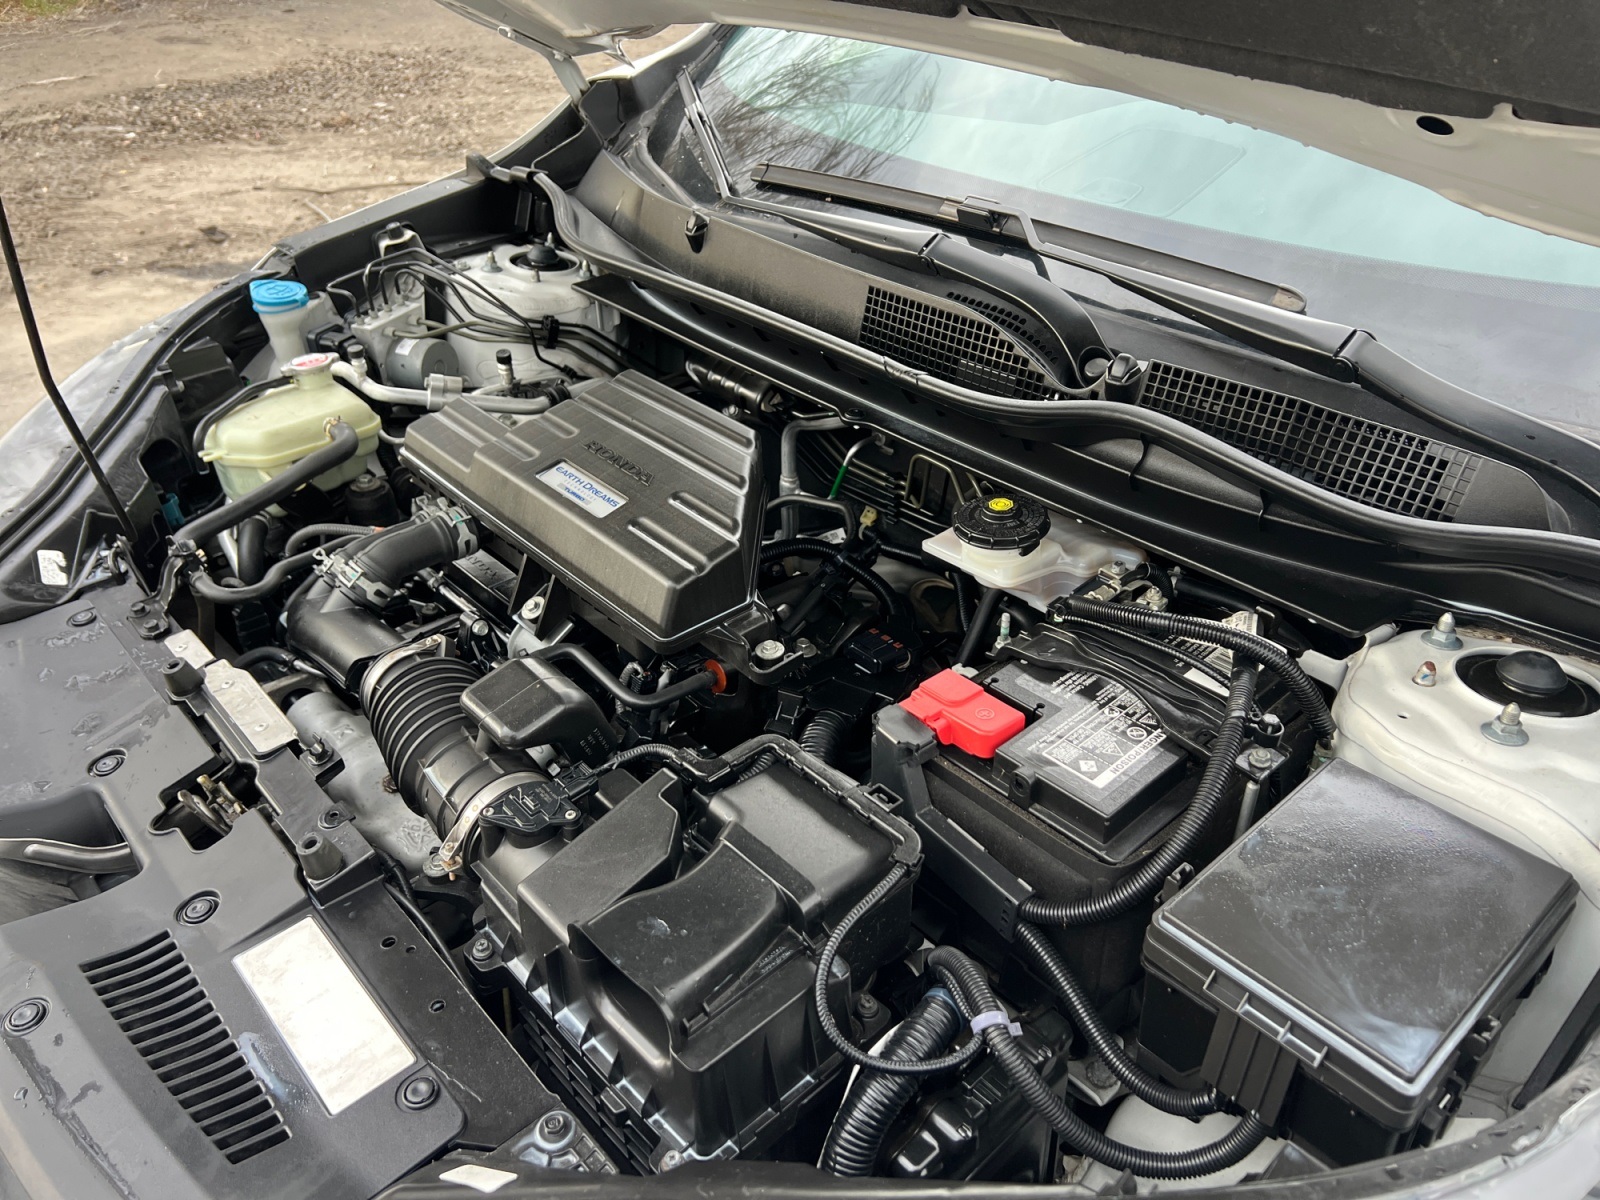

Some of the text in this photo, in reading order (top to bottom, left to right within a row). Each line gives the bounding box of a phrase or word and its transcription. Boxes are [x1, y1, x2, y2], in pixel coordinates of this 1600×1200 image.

[583, 440, 654, 487] HONDA
[555, 466, 620, 508] EARTH DREAMS
[563, 486, 586, 502] TURBO
